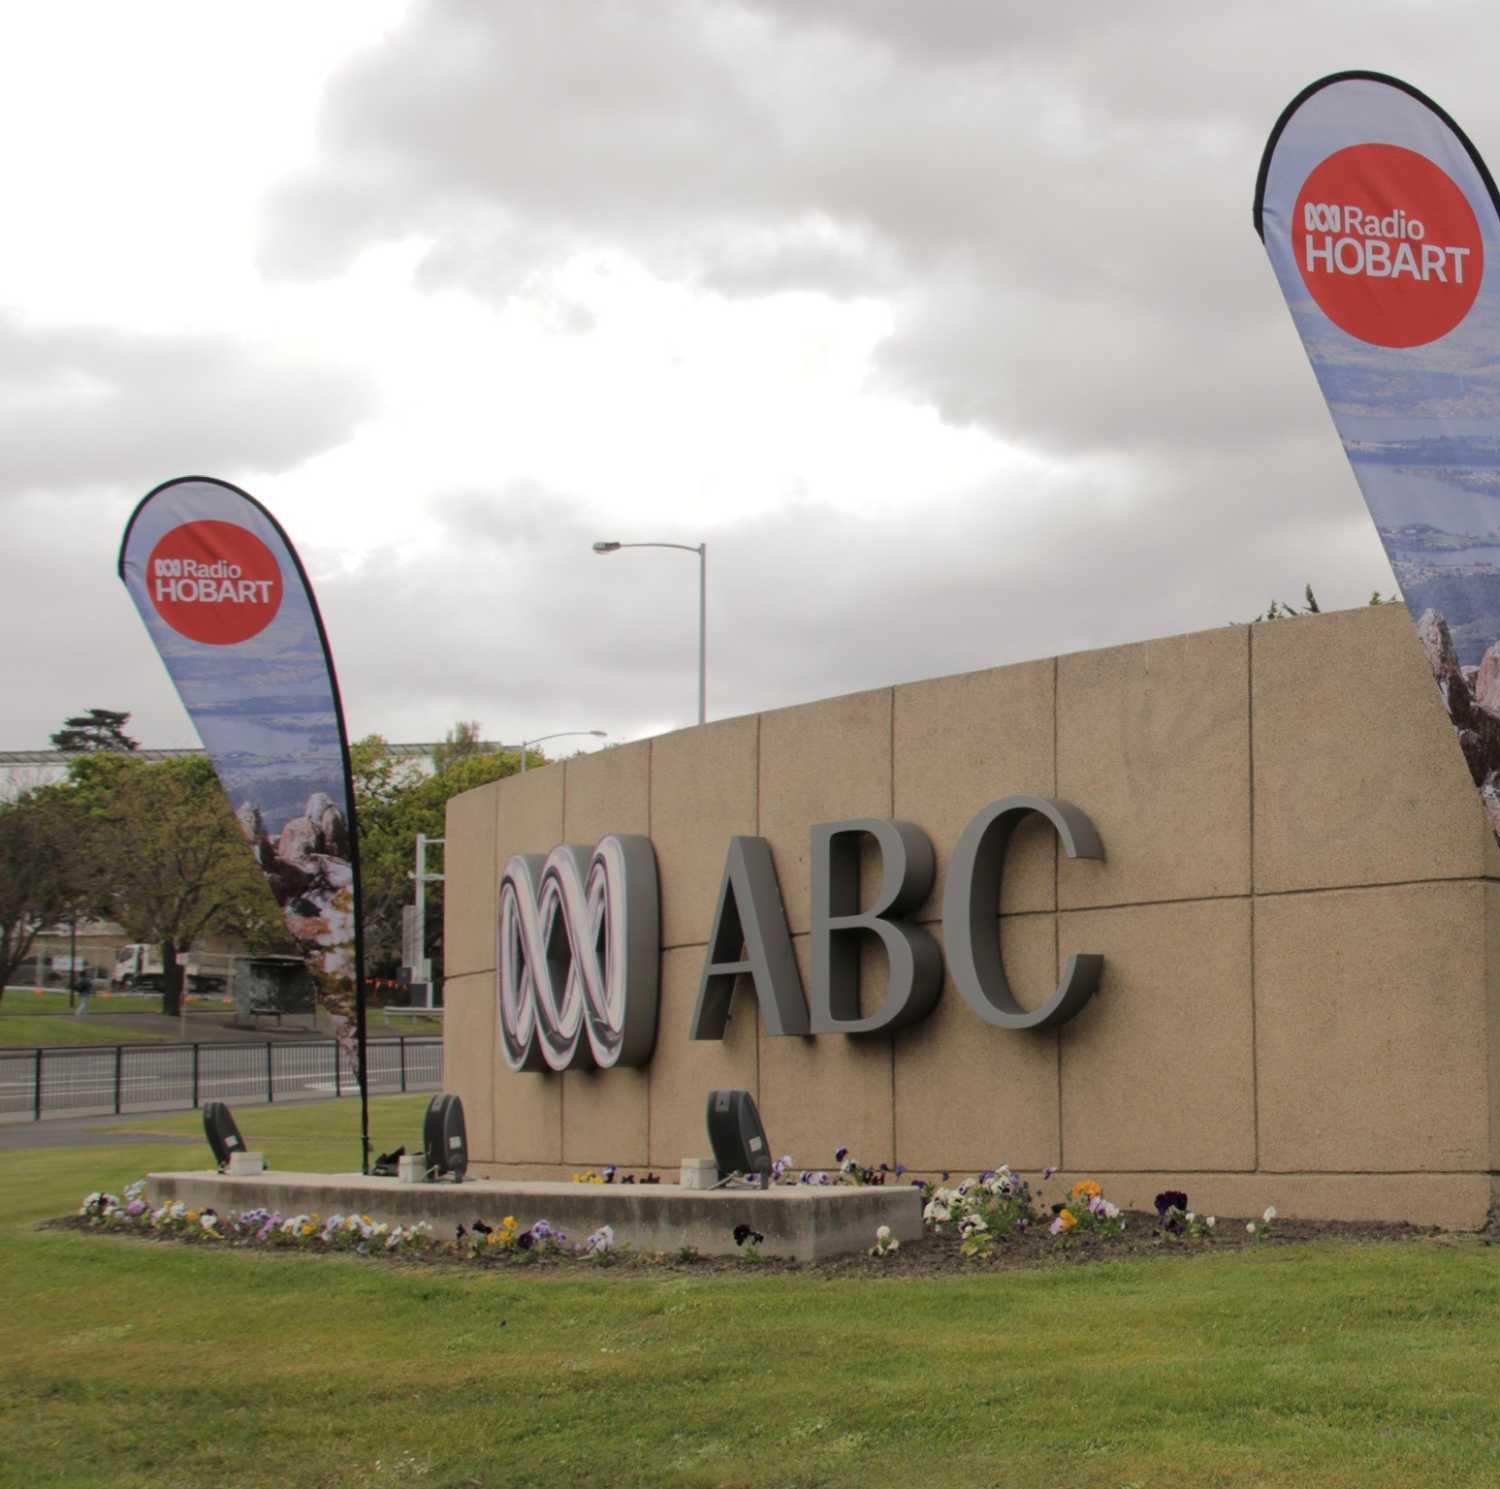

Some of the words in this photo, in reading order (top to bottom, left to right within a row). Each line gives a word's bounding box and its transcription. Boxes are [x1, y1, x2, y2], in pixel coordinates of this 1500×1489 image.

[1344, 206, 1425, 240] Radio
[1305, 235, 1470, 284] HOBART
[183, 559, 242, 579] Radio
[155, 579, 273, 604] HOBART
[689, 795, 1105, 1042] ABC
